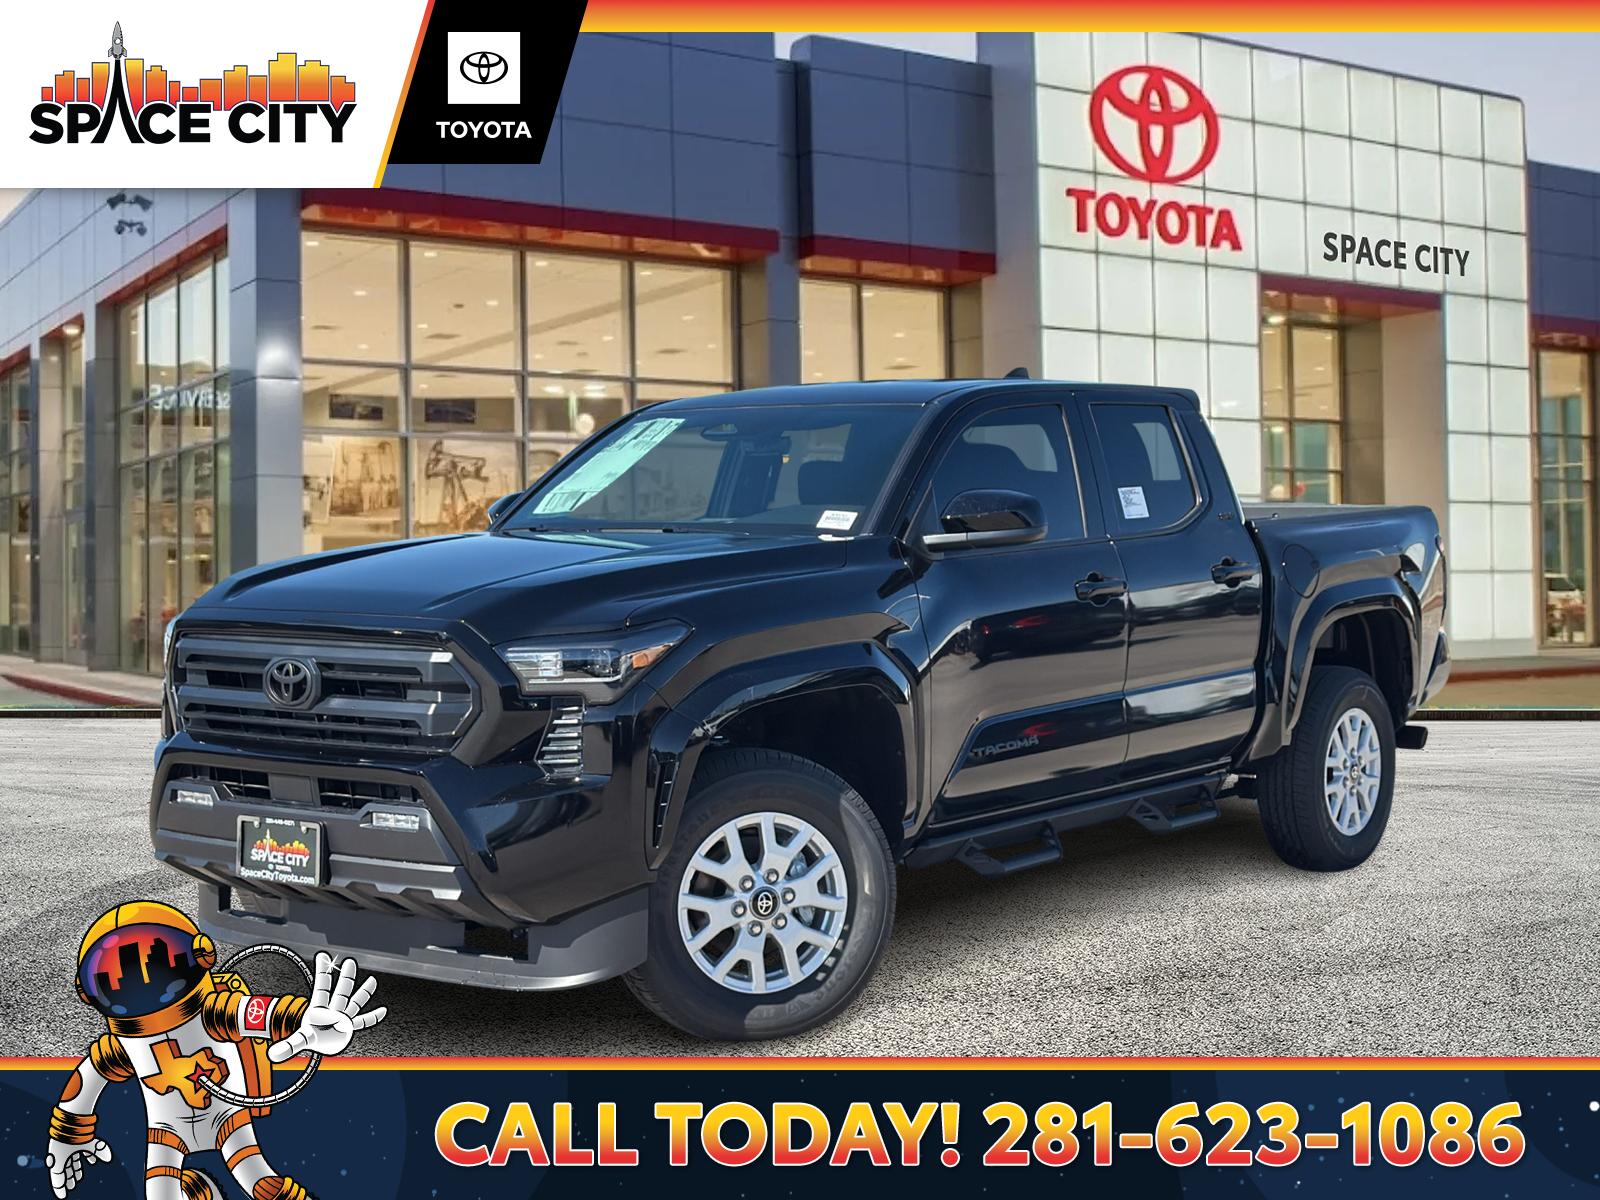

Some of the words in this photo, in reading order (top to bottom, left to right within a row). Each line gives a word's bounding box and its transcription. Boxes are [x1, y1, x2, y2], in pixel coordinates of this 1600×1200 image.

[1066, 187, 1243, 251] TOYOTA
[1322, 231, 1408, 270] SPACE
[1414, 244, 1471, 277] CITY
[974, 735, 1039, 757] TACOMA
[250, 840, 284, 863] SPACE
[285, 853, 310, 867] CITY
[240, 867, 315, 884] SpaceCityToyota.com
